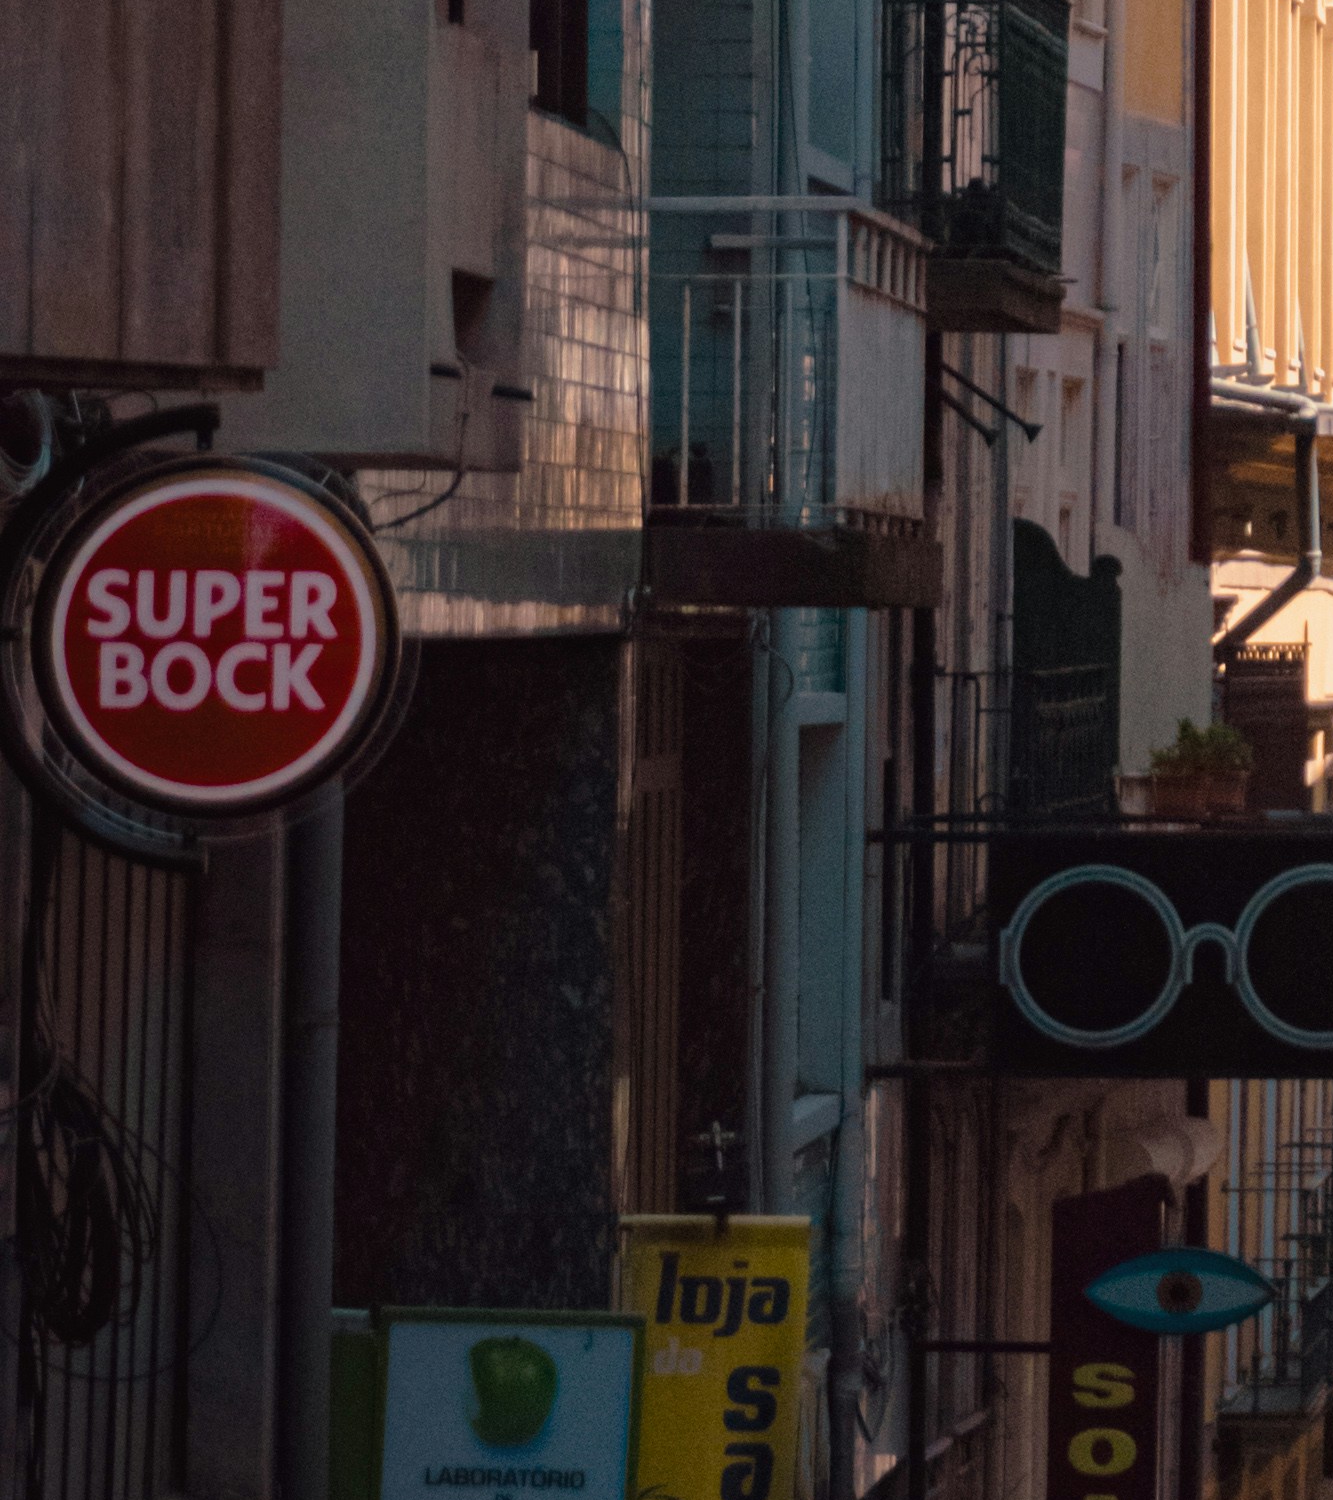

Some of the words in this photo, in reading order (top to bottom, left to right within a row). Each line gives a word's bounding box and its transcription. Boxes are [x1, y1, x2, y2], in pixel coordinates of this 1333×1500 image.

[85, 567, 338, 640] SUPER
[97, 641, 327, 712] BOCK
[655, 1252, 791, 1338] loja
[424, 1465, 586, 1489] LABORATÓRIO
